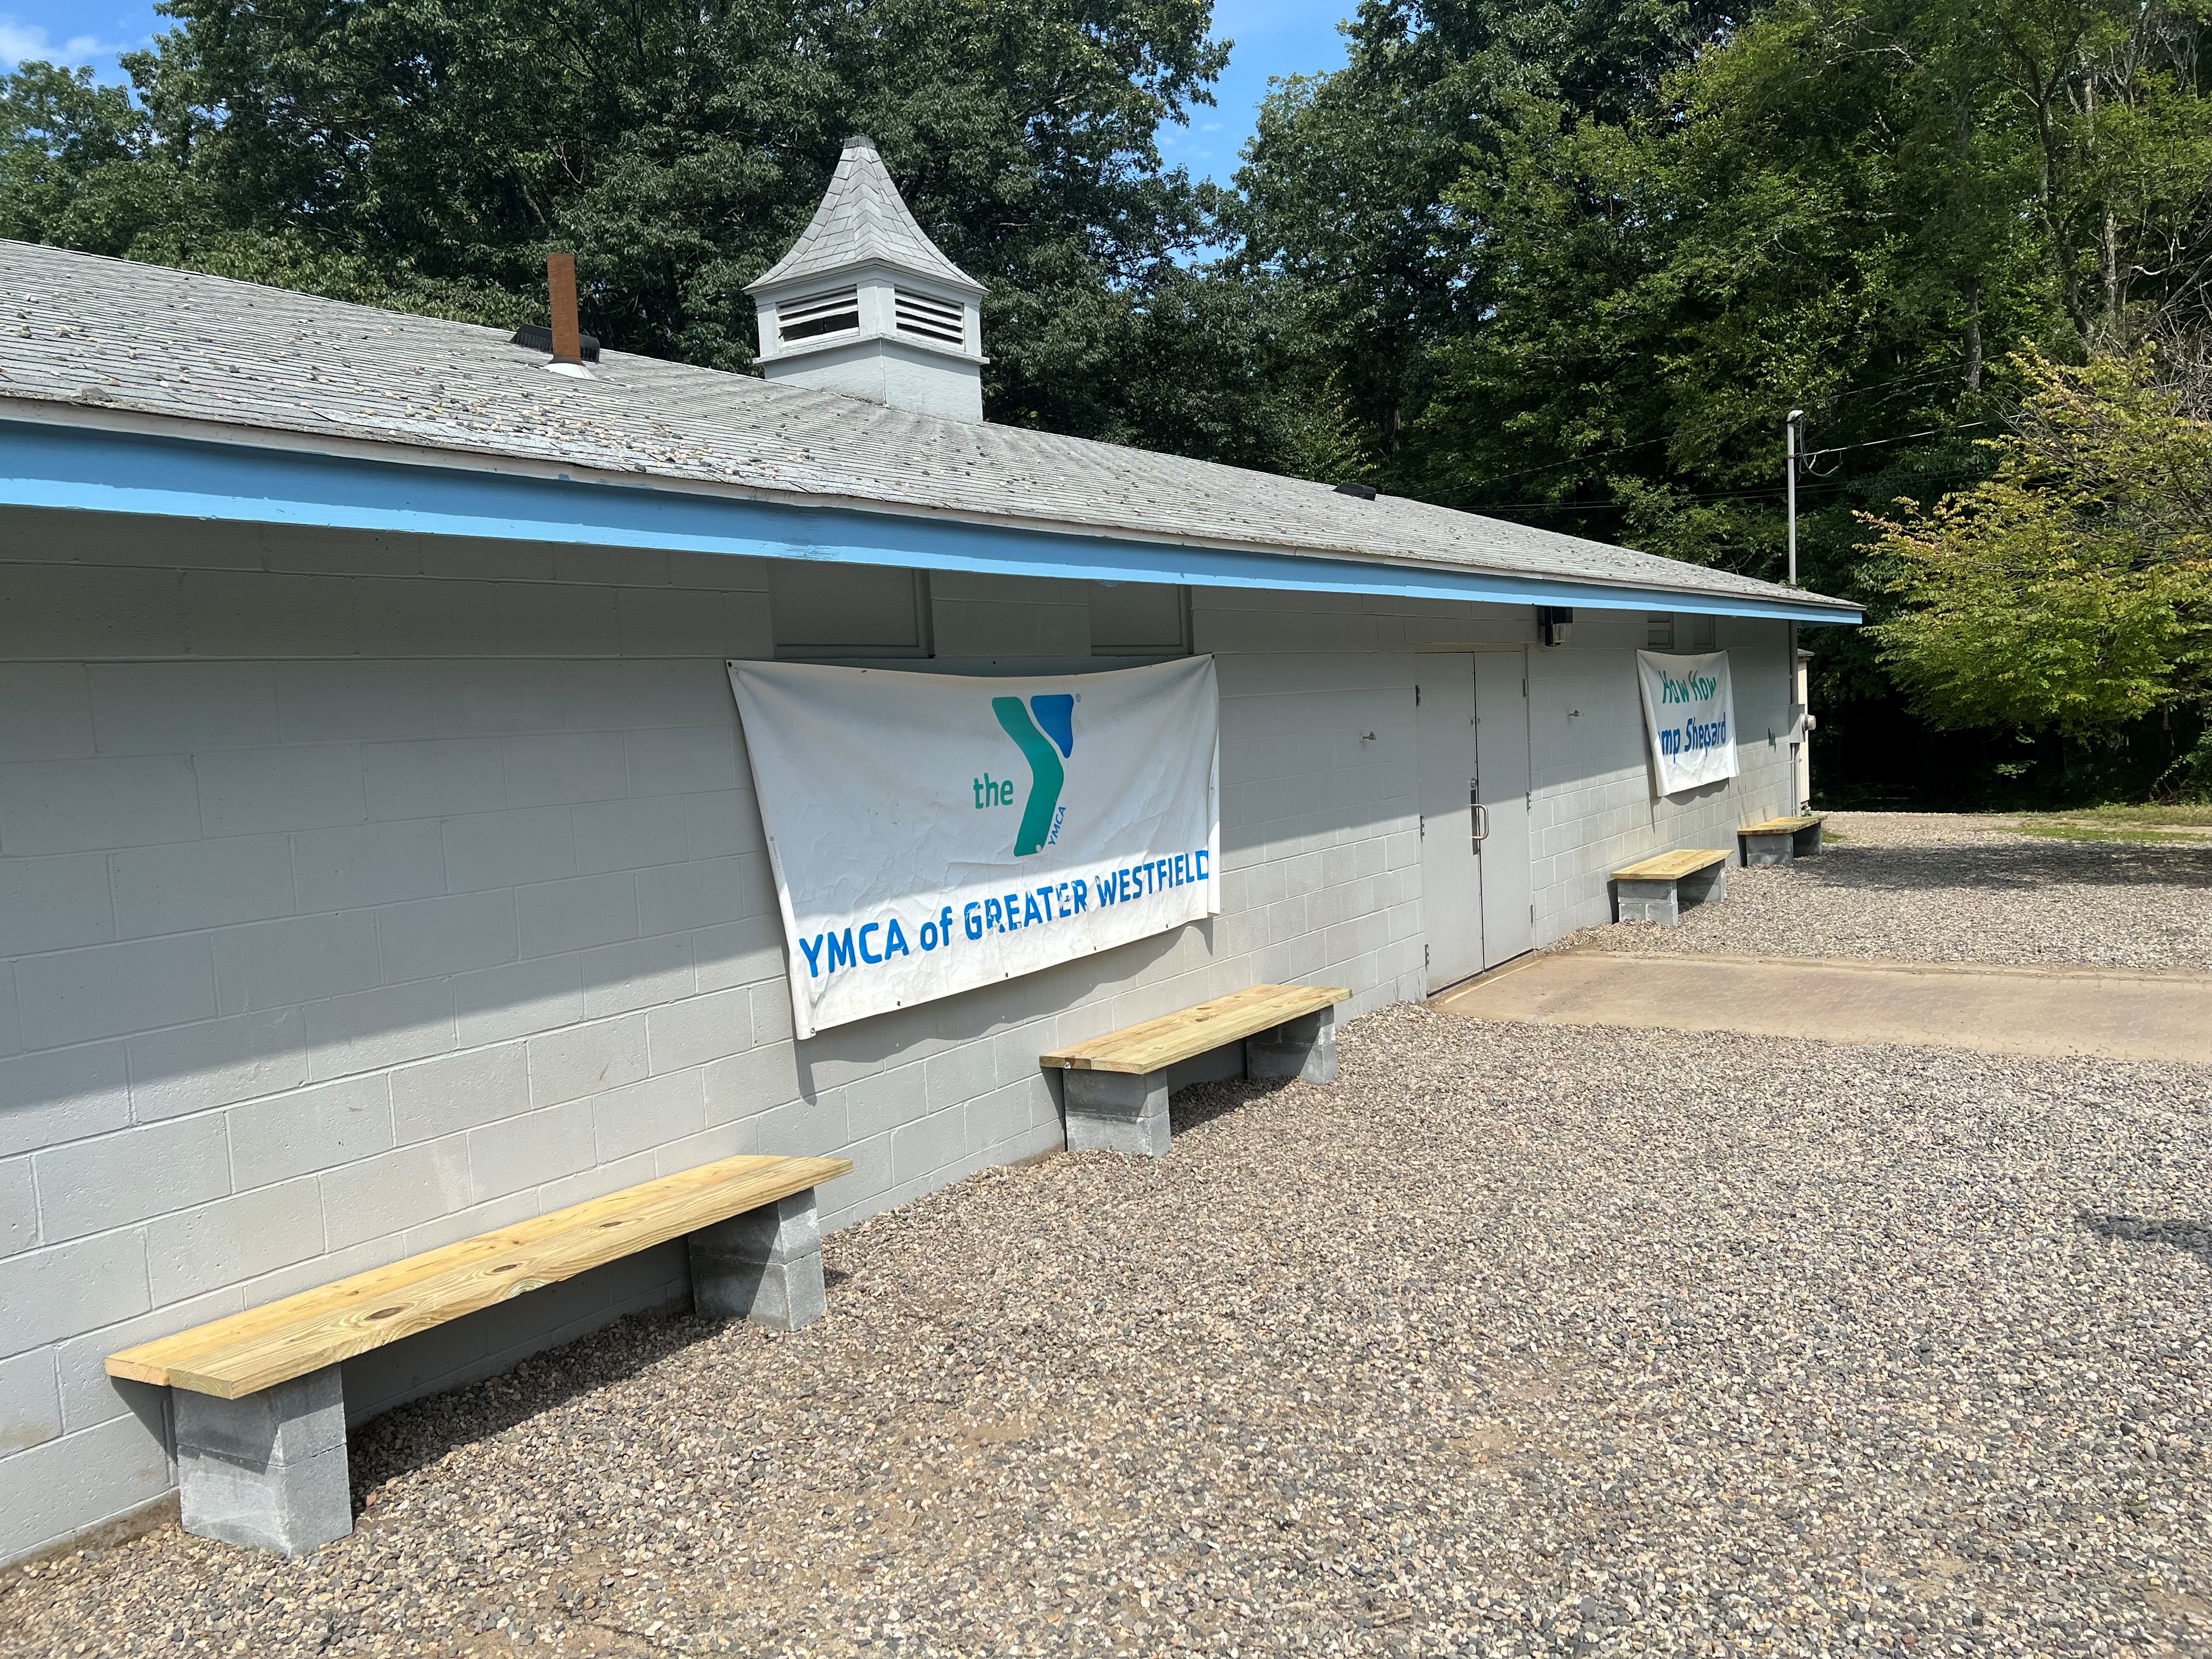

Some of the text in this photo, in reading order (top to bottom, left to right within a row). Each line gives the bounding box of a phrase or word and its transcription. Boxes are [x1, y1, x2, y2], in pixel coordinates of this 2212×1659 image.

[1658, 712, 1726, 764] mp Shepard
[973, 772, 1013, 809] the
[1048, 806, 1066, 845] YMCA
[799, 850, 1209, 978] YMCA of GREATER WESTFIELD
